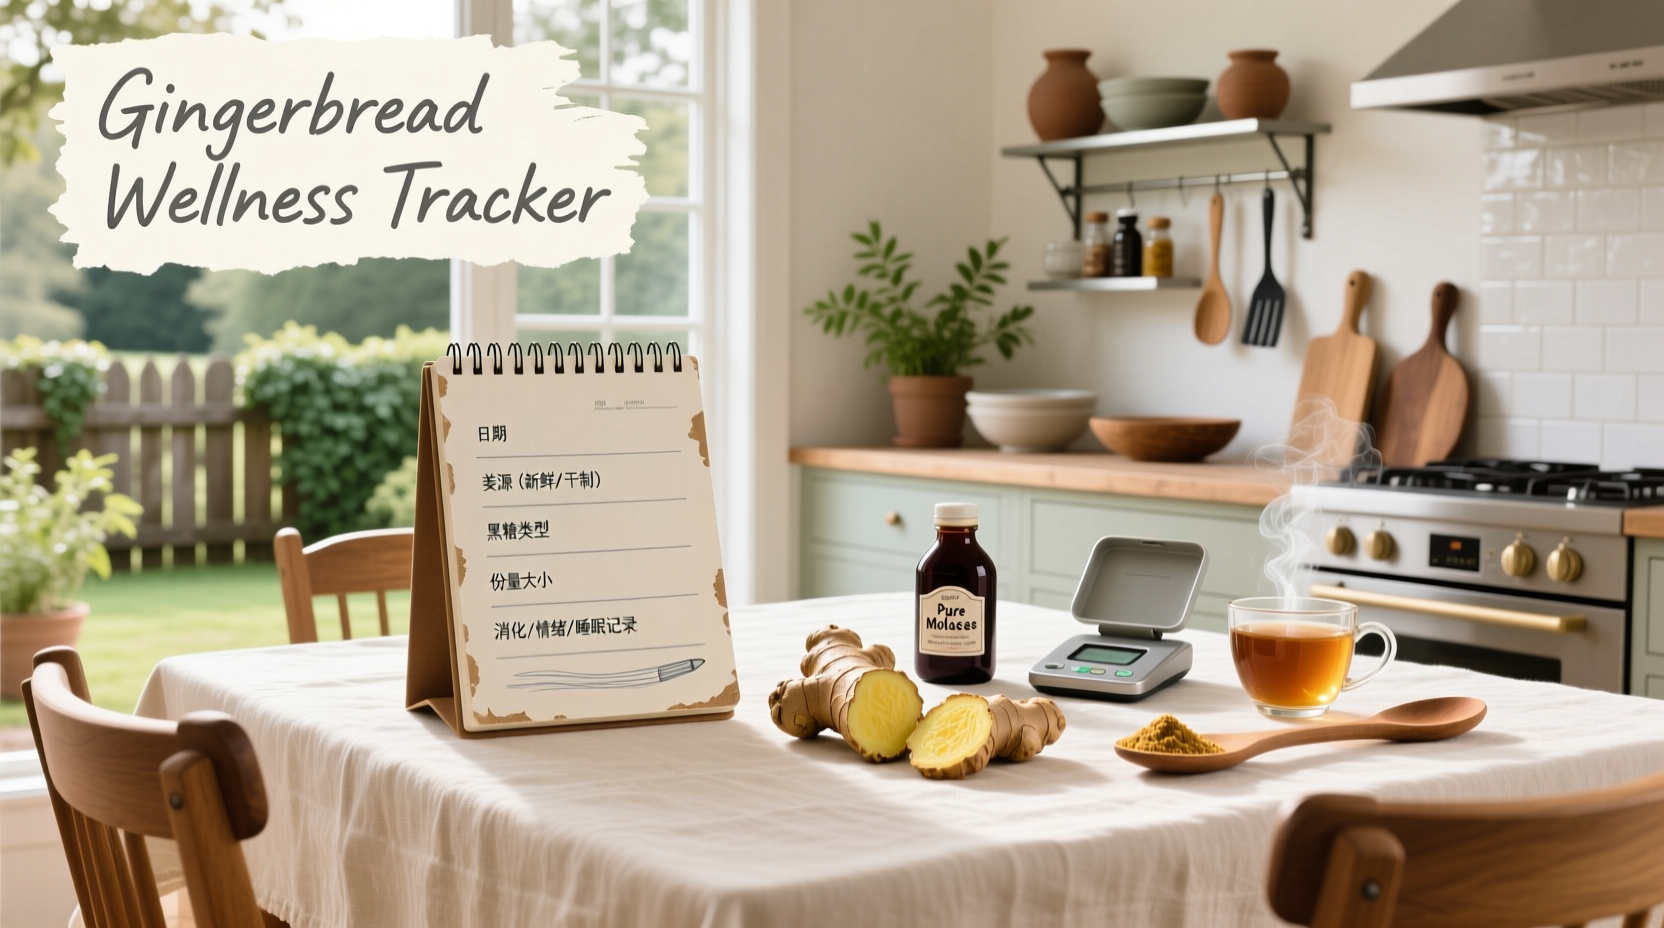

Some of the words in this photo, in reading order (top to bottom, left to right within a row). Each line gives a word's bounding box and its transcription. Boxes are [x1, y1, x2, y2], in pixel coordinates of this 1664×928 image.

[478, 424, 507, 443] 日期
[486, 519, 550, 542] 黑糖类型
[489, 570, 553, 592] 份量大小
[937, 603, 966, 617] Pure
